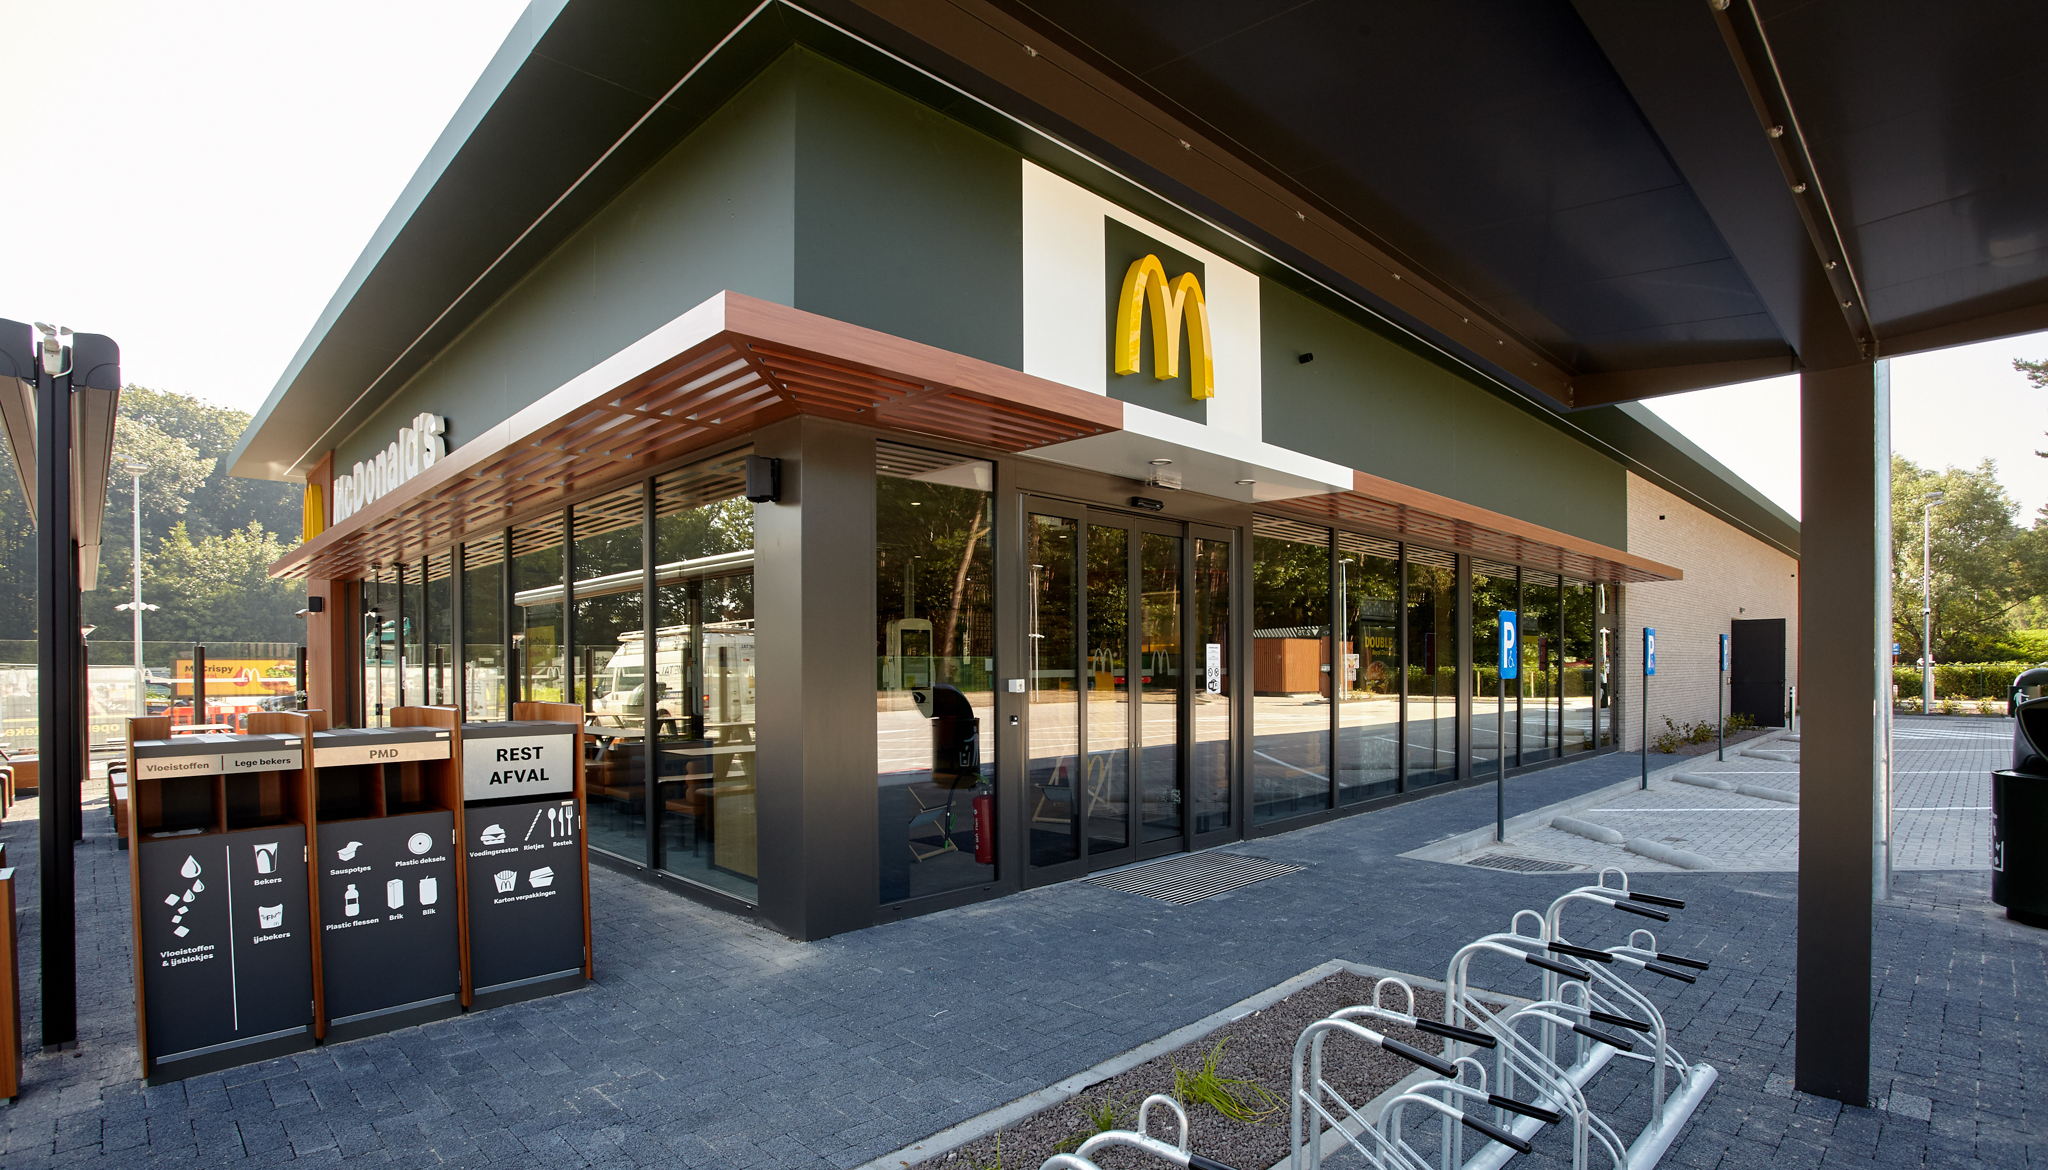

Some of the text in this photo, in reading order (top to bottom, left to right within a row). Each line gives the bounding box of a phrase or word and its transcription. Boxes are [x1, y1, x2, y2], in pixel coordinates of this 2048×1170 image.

[333, 412, 445, 526] McDonald's
[1364, 636, 1393, 648] DOUBLE
[1504, 622, 1514, 668] P
[184, 665, 233, 674] MCrispy
[369, 748, 399, 759] PMD
[496, 746, 544, 762] REST
[146, 761, 210, 772] Vloeistoffen
[235, 757, 291, 768] Lege bekers
[489, 768, 549, 785] AFVAL
[469, 847, 519, 858] Voedingsresten
[523, 843, 545, 851] Rietjes
[395, 856, 446, 867] Plastic deksels
[330, 865, 372, 876] Sauspotjes
[254, 877, 282, 886] Bekers
[493, 890, 556, 904] Karton verpakkingen
[389, 913, 404, 921] Brik
[422, 908, 436, 916] Blik
[326, 918, 379, 931] Plastic flessen
[160, 944, 215, 958] Vloeistoffen
[170, 953, 214, 967] ijsblokjes
